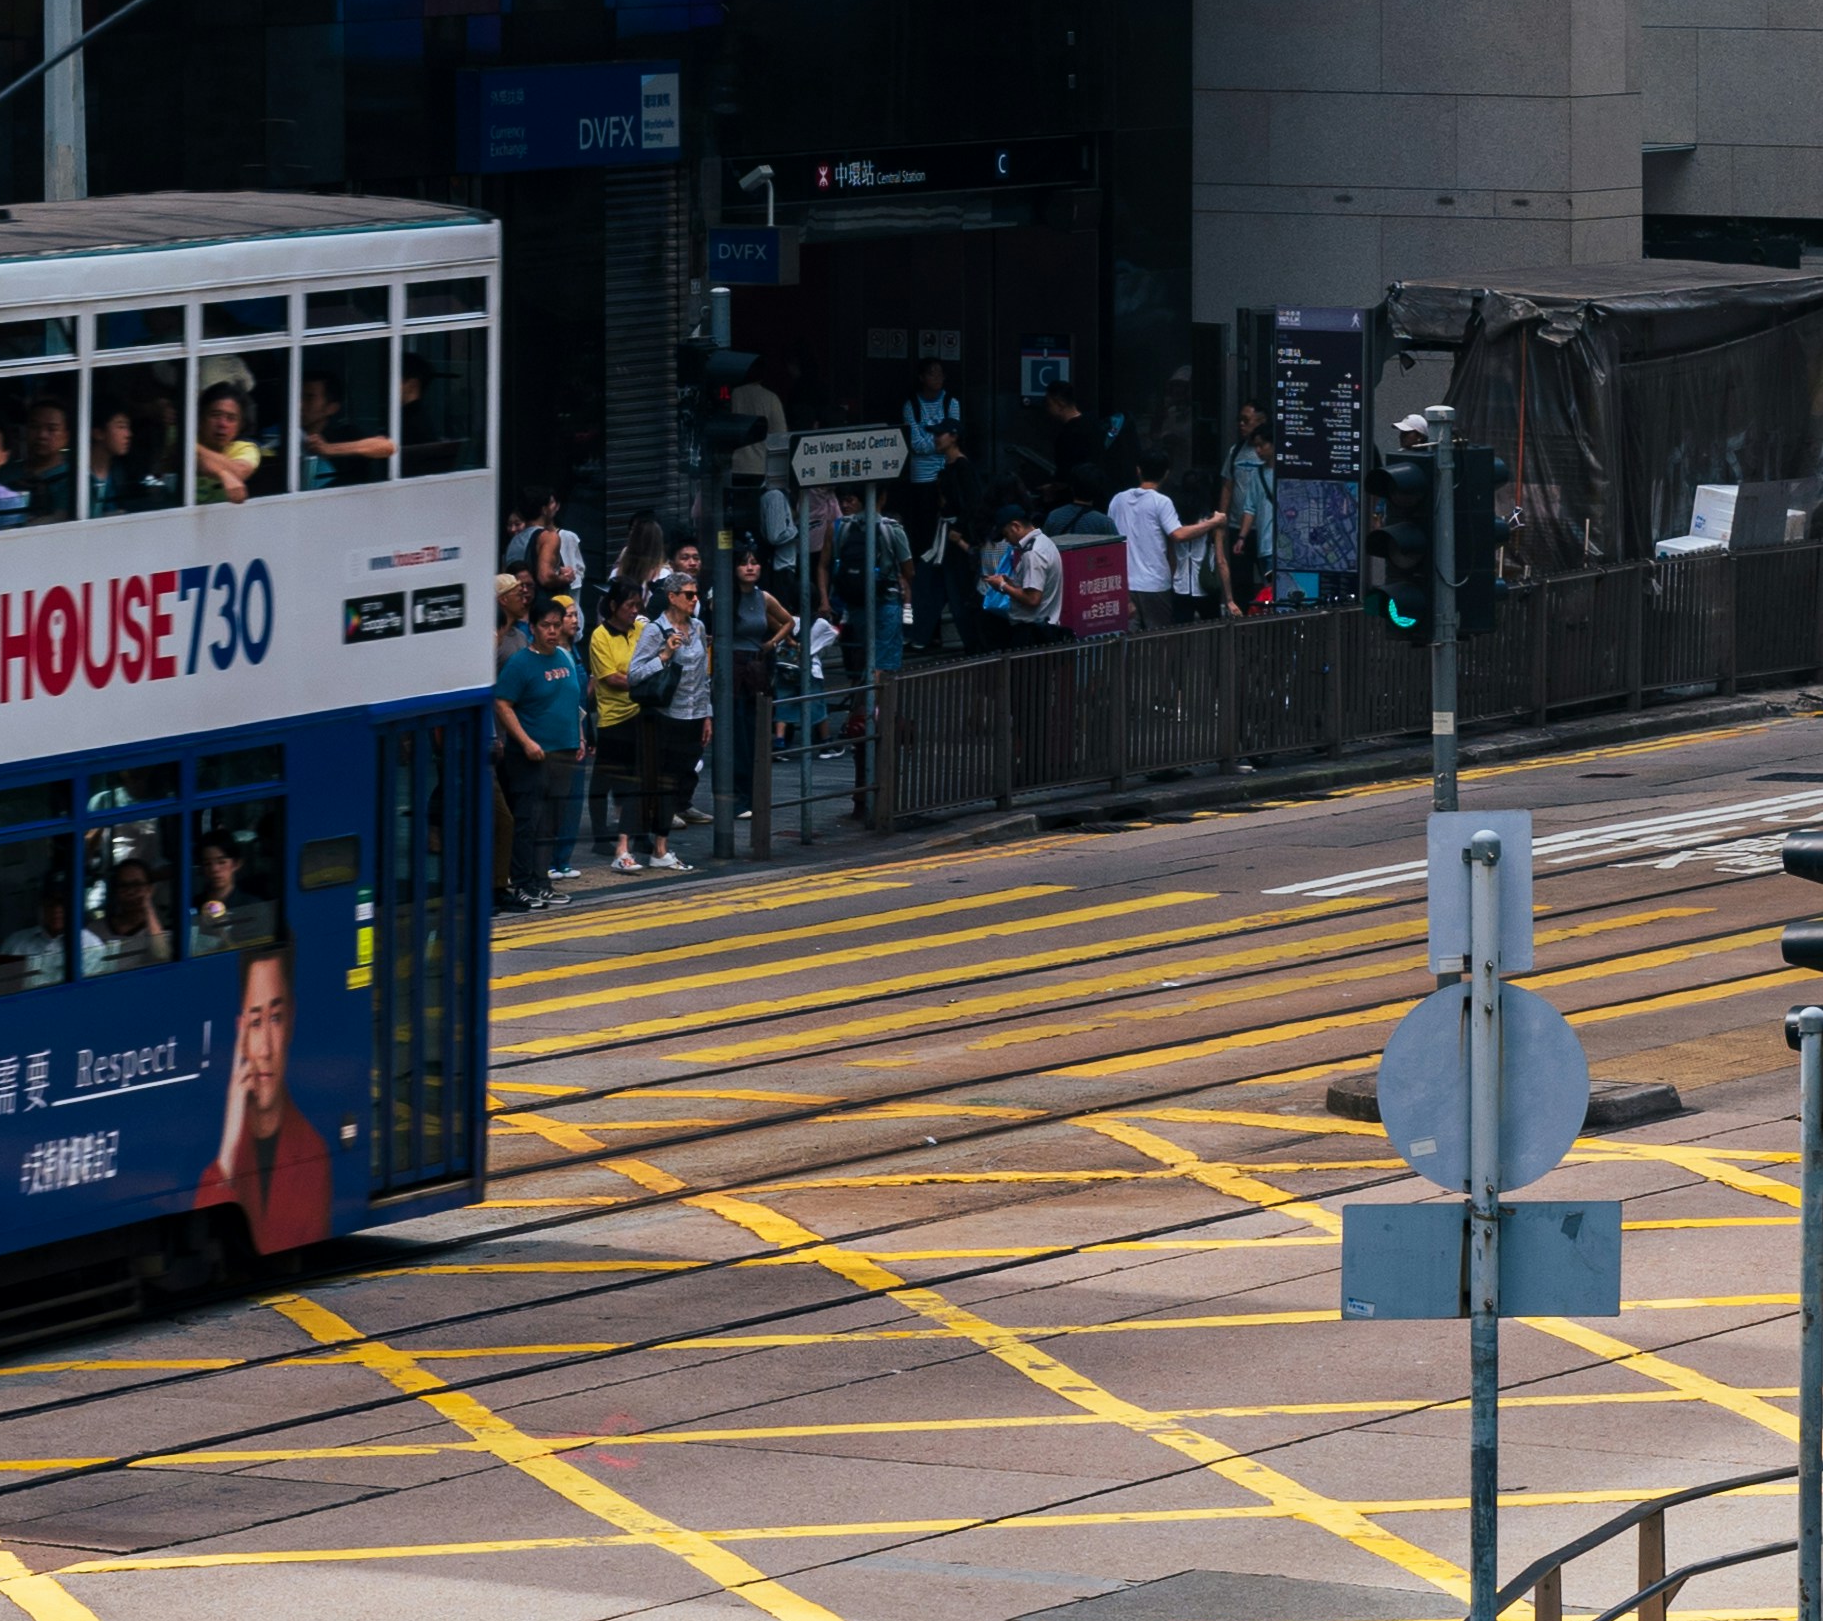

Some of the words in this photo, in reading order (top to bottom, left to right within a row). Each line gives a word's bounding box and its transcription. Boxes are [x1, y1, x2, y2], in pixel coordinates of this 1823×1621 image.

[490, 125, 526, 140] Currency
[579, 115, 635, 150] DVFX
[490, 142, 528, 159] Exchange
[834, 158, 875, 190] 中環站
[877, 169, 901, 186] Central
[902, 168, 927, 184] Station
[998, 152, 1008, 175] C
[718, 242, 768, 261] DVFX
[1300, 358, 1322, 366] Station
[803, 442, 818, 456] Des
[820, 439, 844, 454] Voeux
[846, 437, 866, 452] Road
[868, 434, 898, 450] Central
[830, 457, 873, 479] 德輔道中
[74, 1036, 179, 1089] Respect
